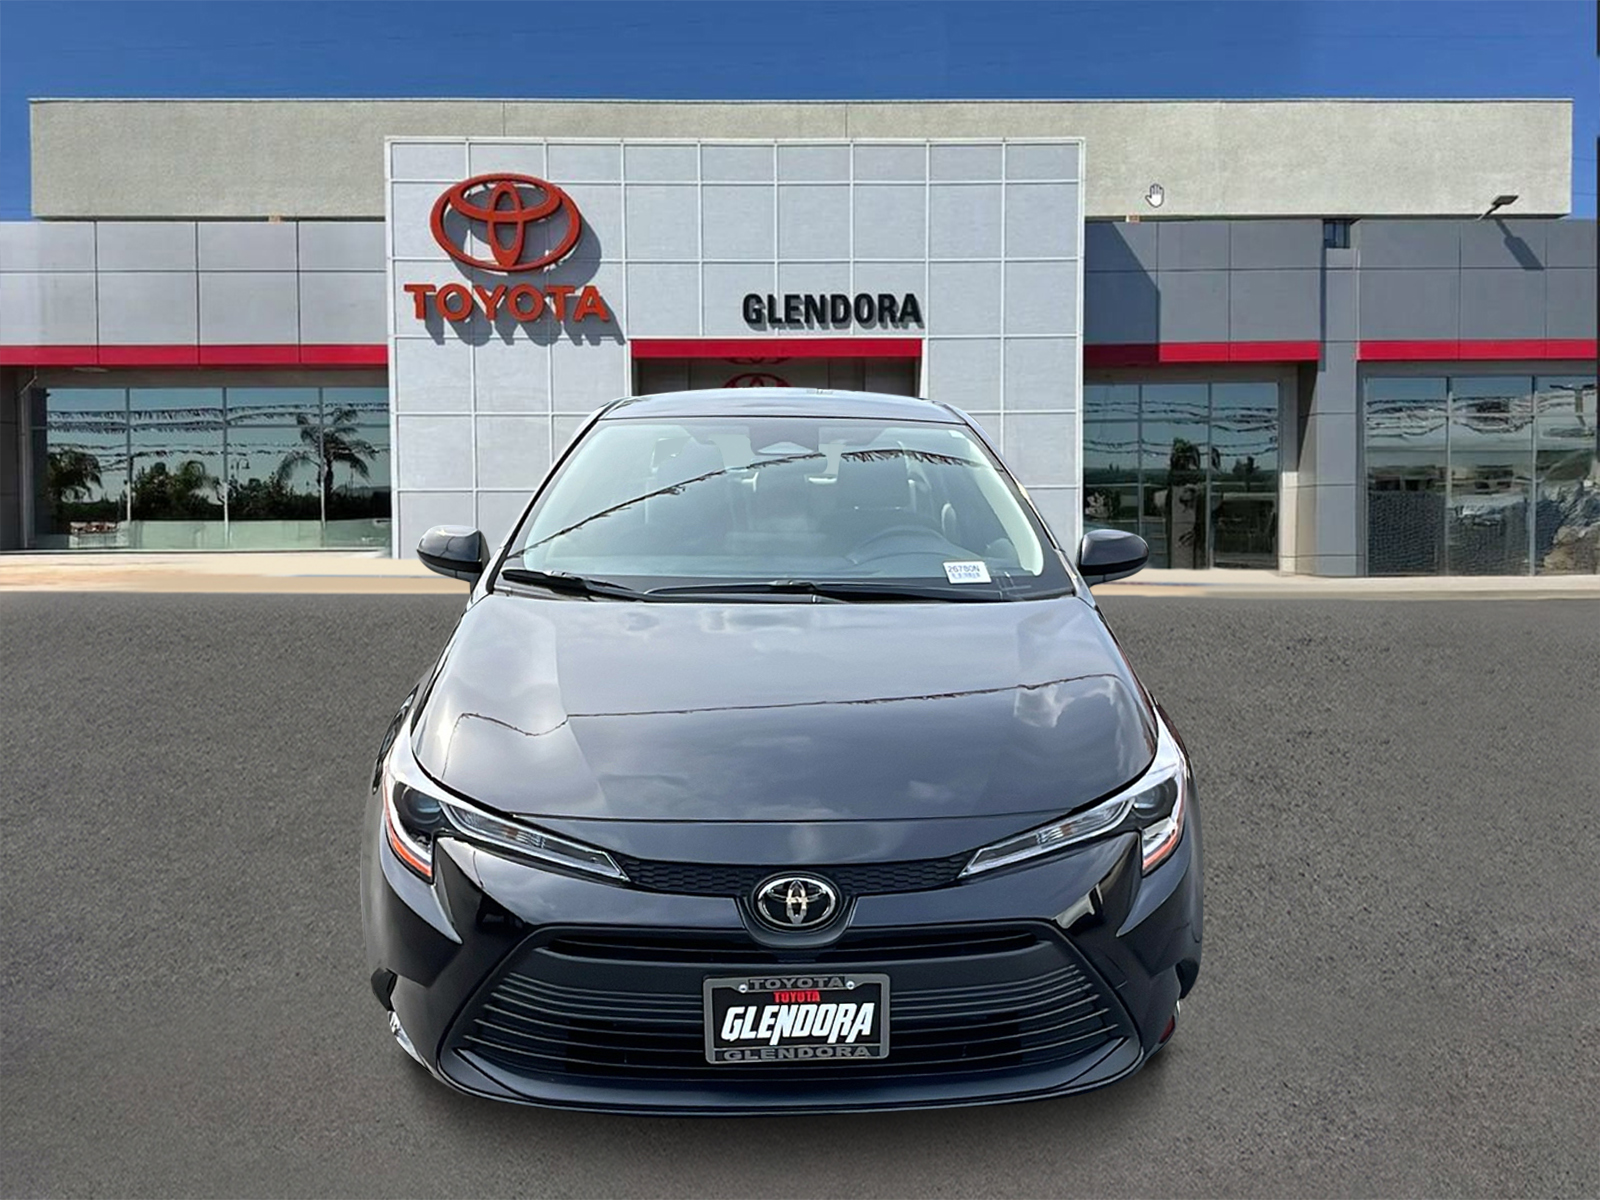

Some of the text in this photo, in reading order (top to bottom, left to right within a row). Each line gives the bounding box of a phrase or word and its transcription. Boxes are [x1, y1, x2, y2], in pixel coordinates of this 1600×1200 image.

[404, 283, 611, 323] TOYOTA
[742, 293, 922, 325] GLENDORA
[750, 977, 844, 990] TOYOTA
[773, 990, 821, 1004] TOYOTA
[721, 1003, 875, 1046] GLENDORA
[724, 1046, 872, 1061] GLENDORA
